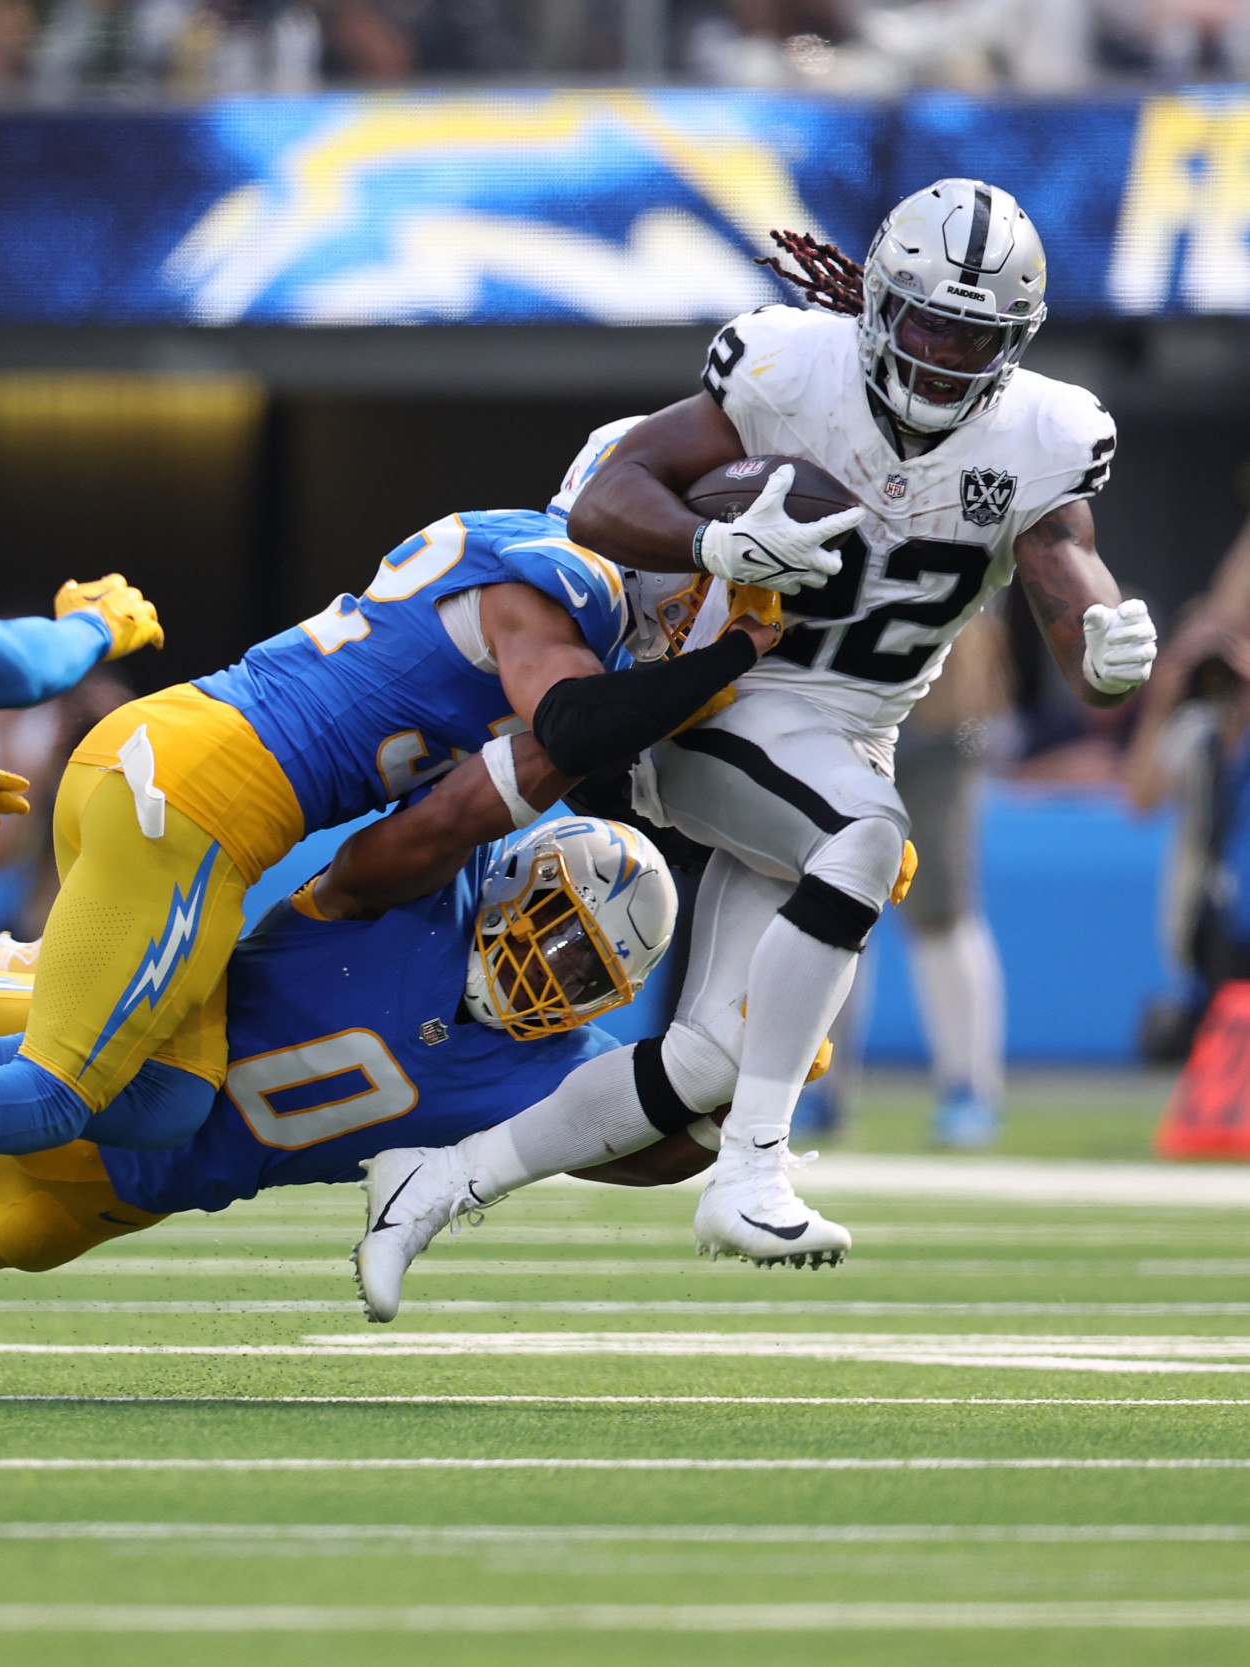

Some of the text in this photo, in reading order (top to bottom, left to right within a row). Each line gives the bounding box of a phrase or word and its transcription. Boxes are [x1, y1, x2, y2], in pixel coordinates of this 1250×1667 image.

[946, 285, 986, 302] RAIDERS
[731, 461, 760, 474] NFL
[886, 482, 905, 496] NFL
[966, 483, 1012, 506] LXV
[762, 529, 994, 686] 22
[224, 1027, 420, 1151] 0
